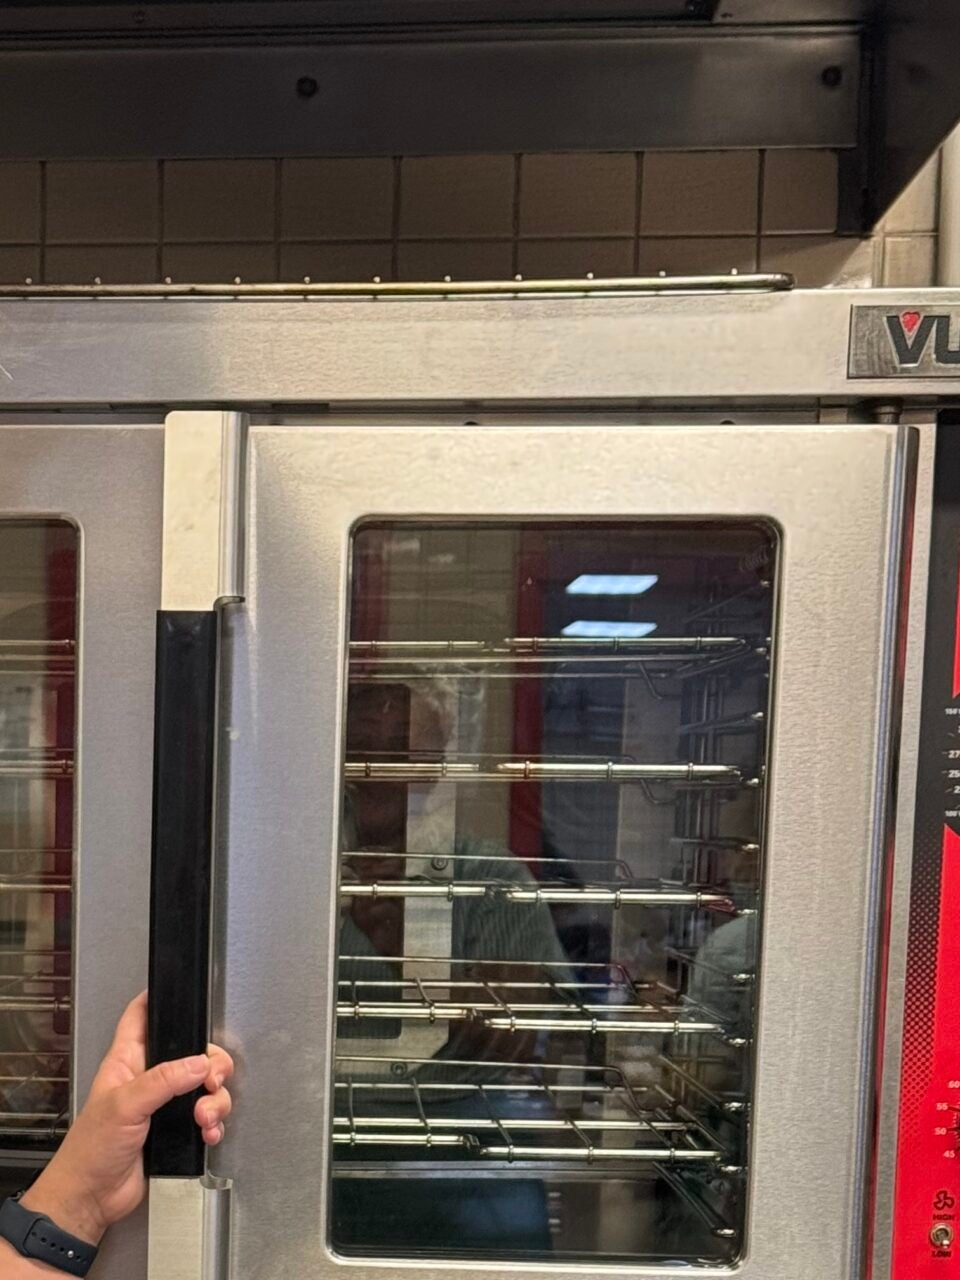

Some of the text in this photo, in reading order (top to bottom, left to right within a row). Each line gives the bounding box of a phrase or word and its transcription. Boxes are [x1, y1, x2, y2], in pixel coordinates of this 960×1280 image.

[936, 1102, 948, 1110] 55
[935, 1127, 947, 1135] 50
[944, 1150, 955, 1158] 45
